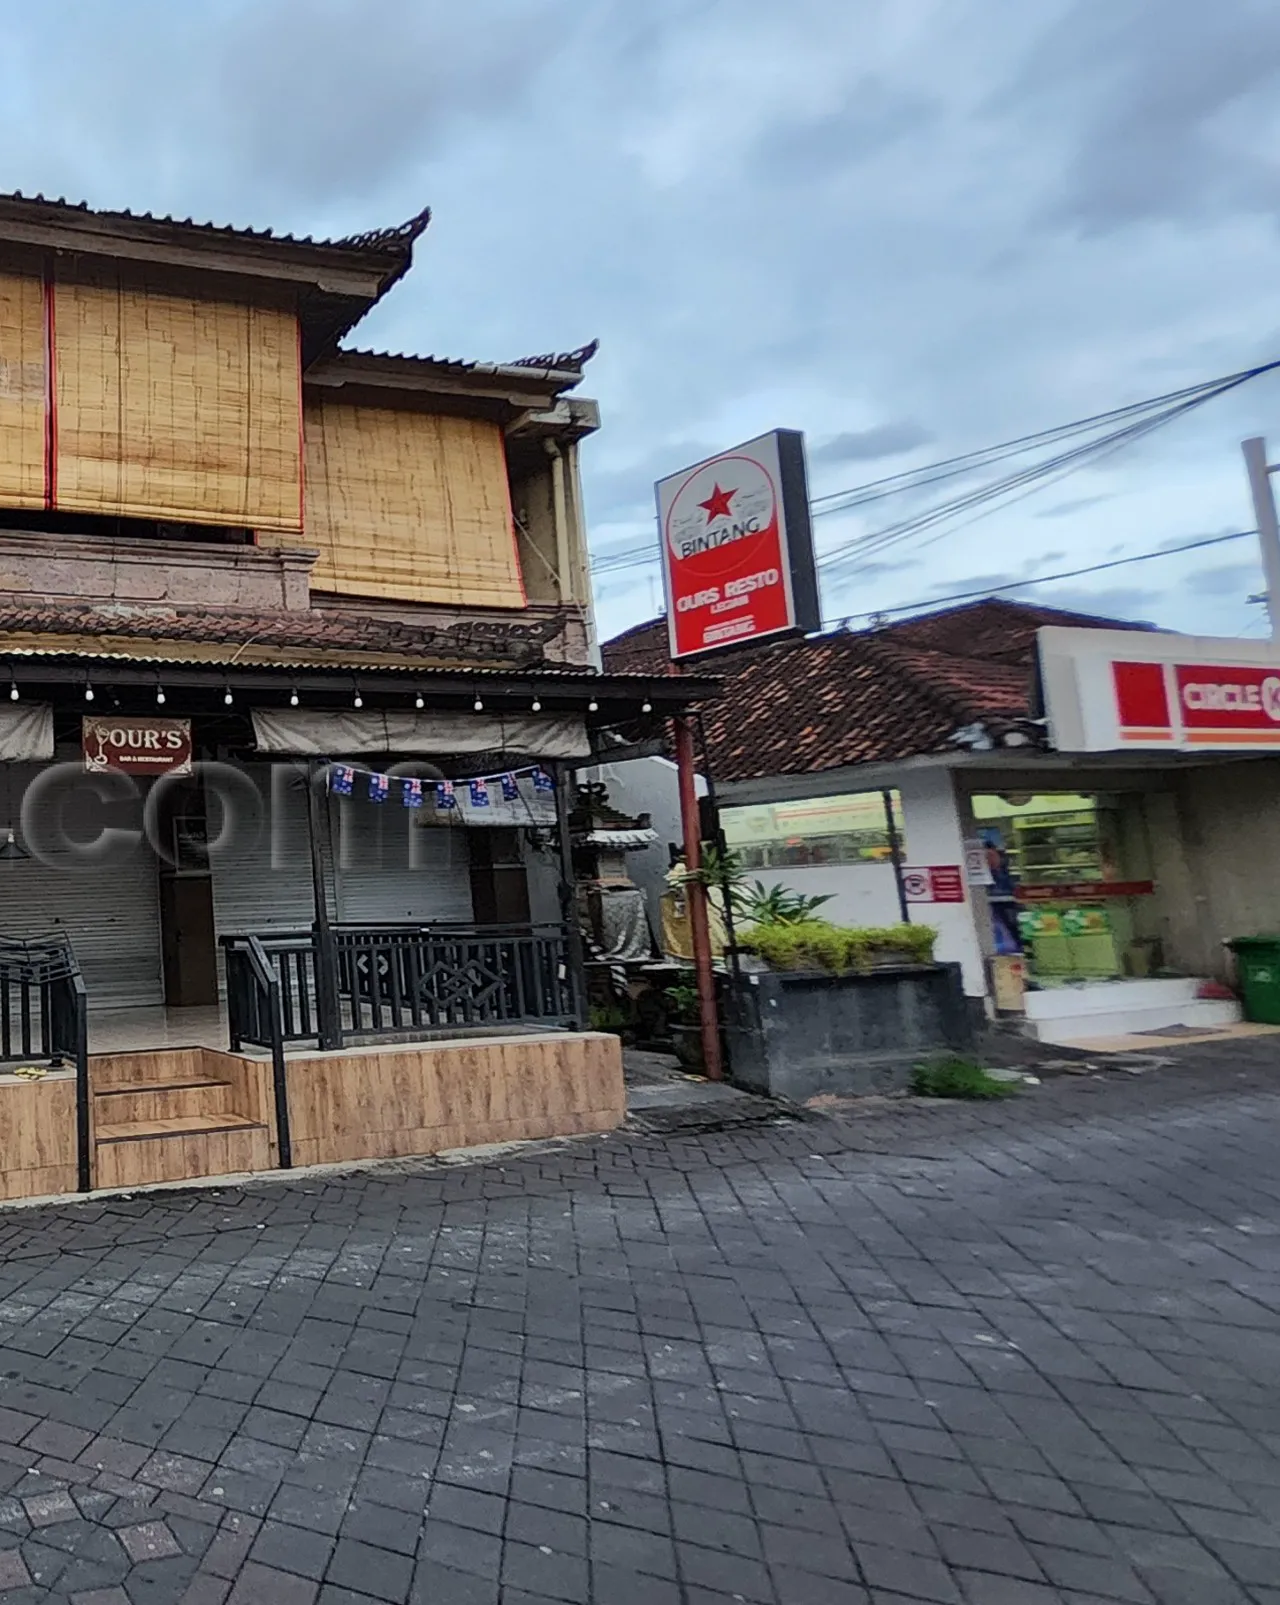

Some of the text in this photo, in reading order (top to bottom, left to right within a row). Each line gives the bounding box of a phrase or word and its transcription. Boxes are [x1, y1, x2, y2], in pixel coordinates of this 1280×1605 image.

[681, 516, 760, 558] BINTANG
[677, 568, 779, 613] OURS RESTO
[1183, 683, 1262, 711] CIRCLE
